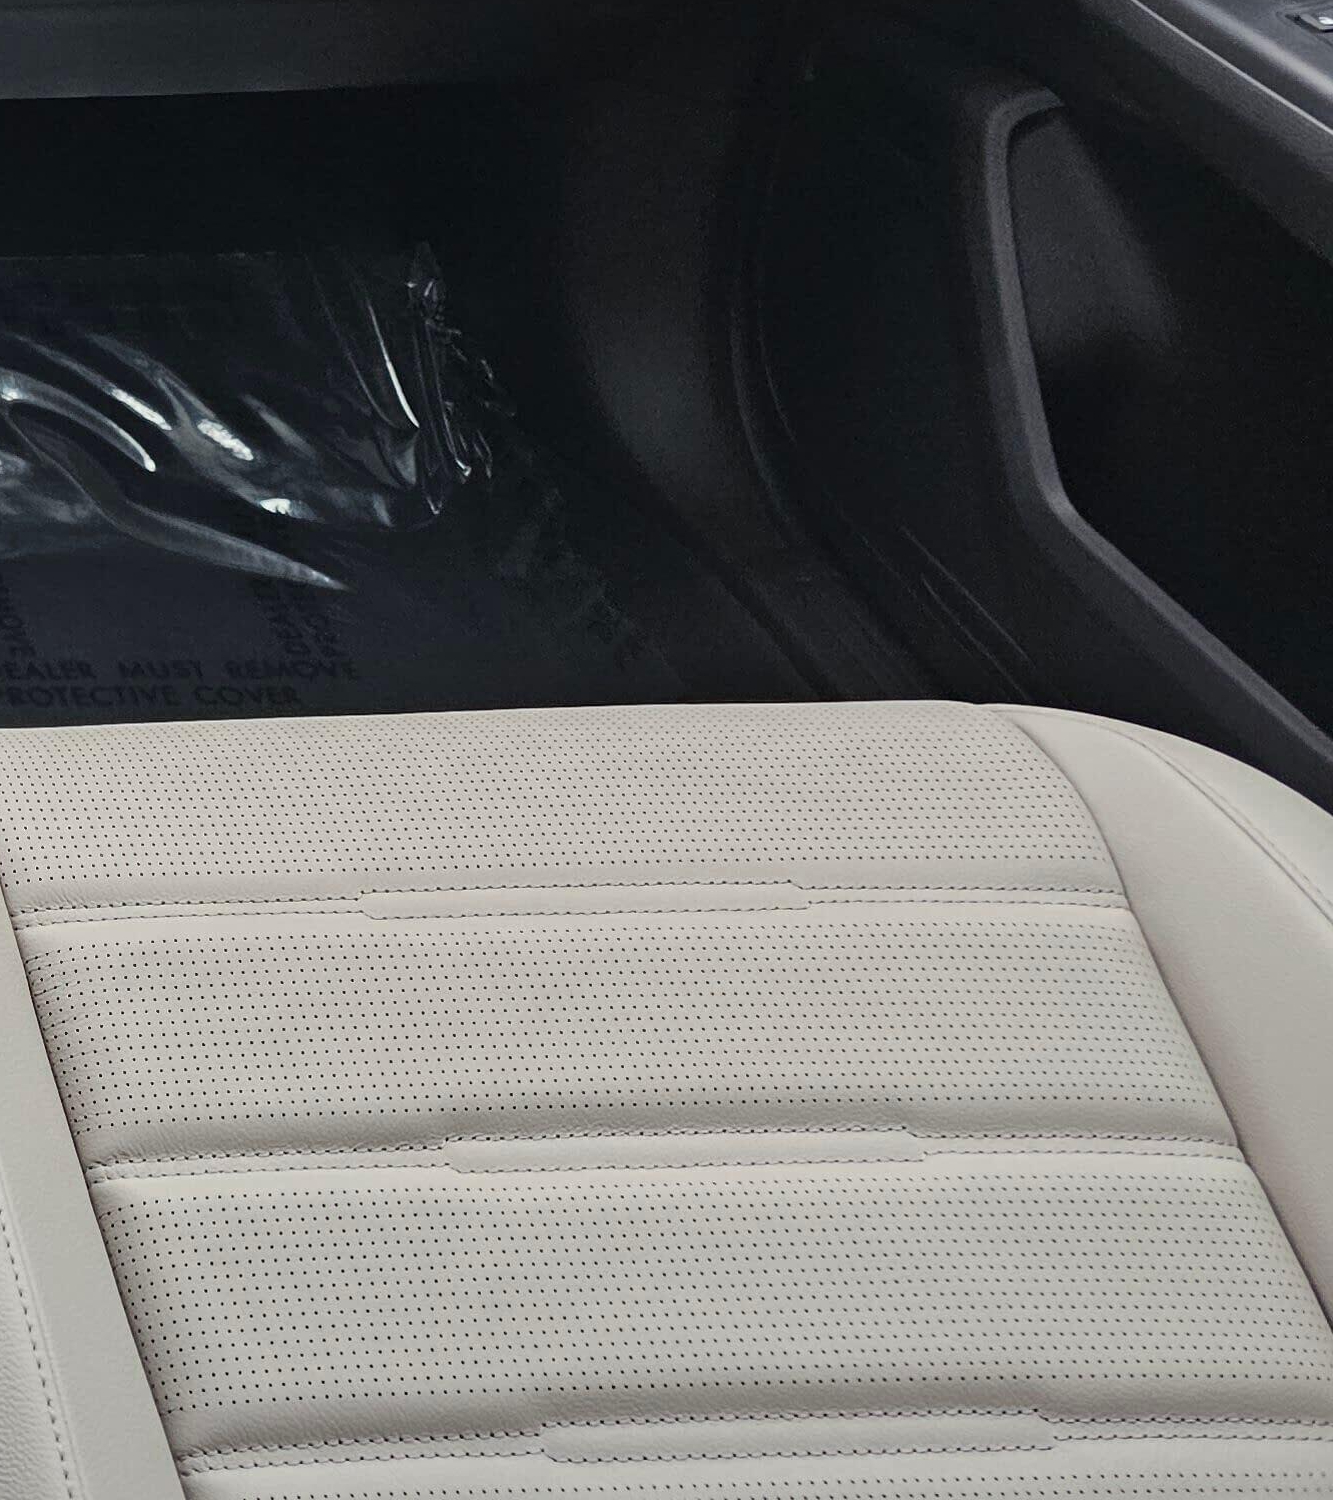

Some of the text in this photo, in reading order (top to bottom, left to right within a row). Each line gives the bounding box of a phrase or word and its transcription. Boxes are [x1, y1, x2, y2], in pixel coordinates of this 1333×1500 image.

[116, 657, 206, 681] MUST
[222, 657, 362, 681] REMOVE
[190, 682, 303, 707] COVER
